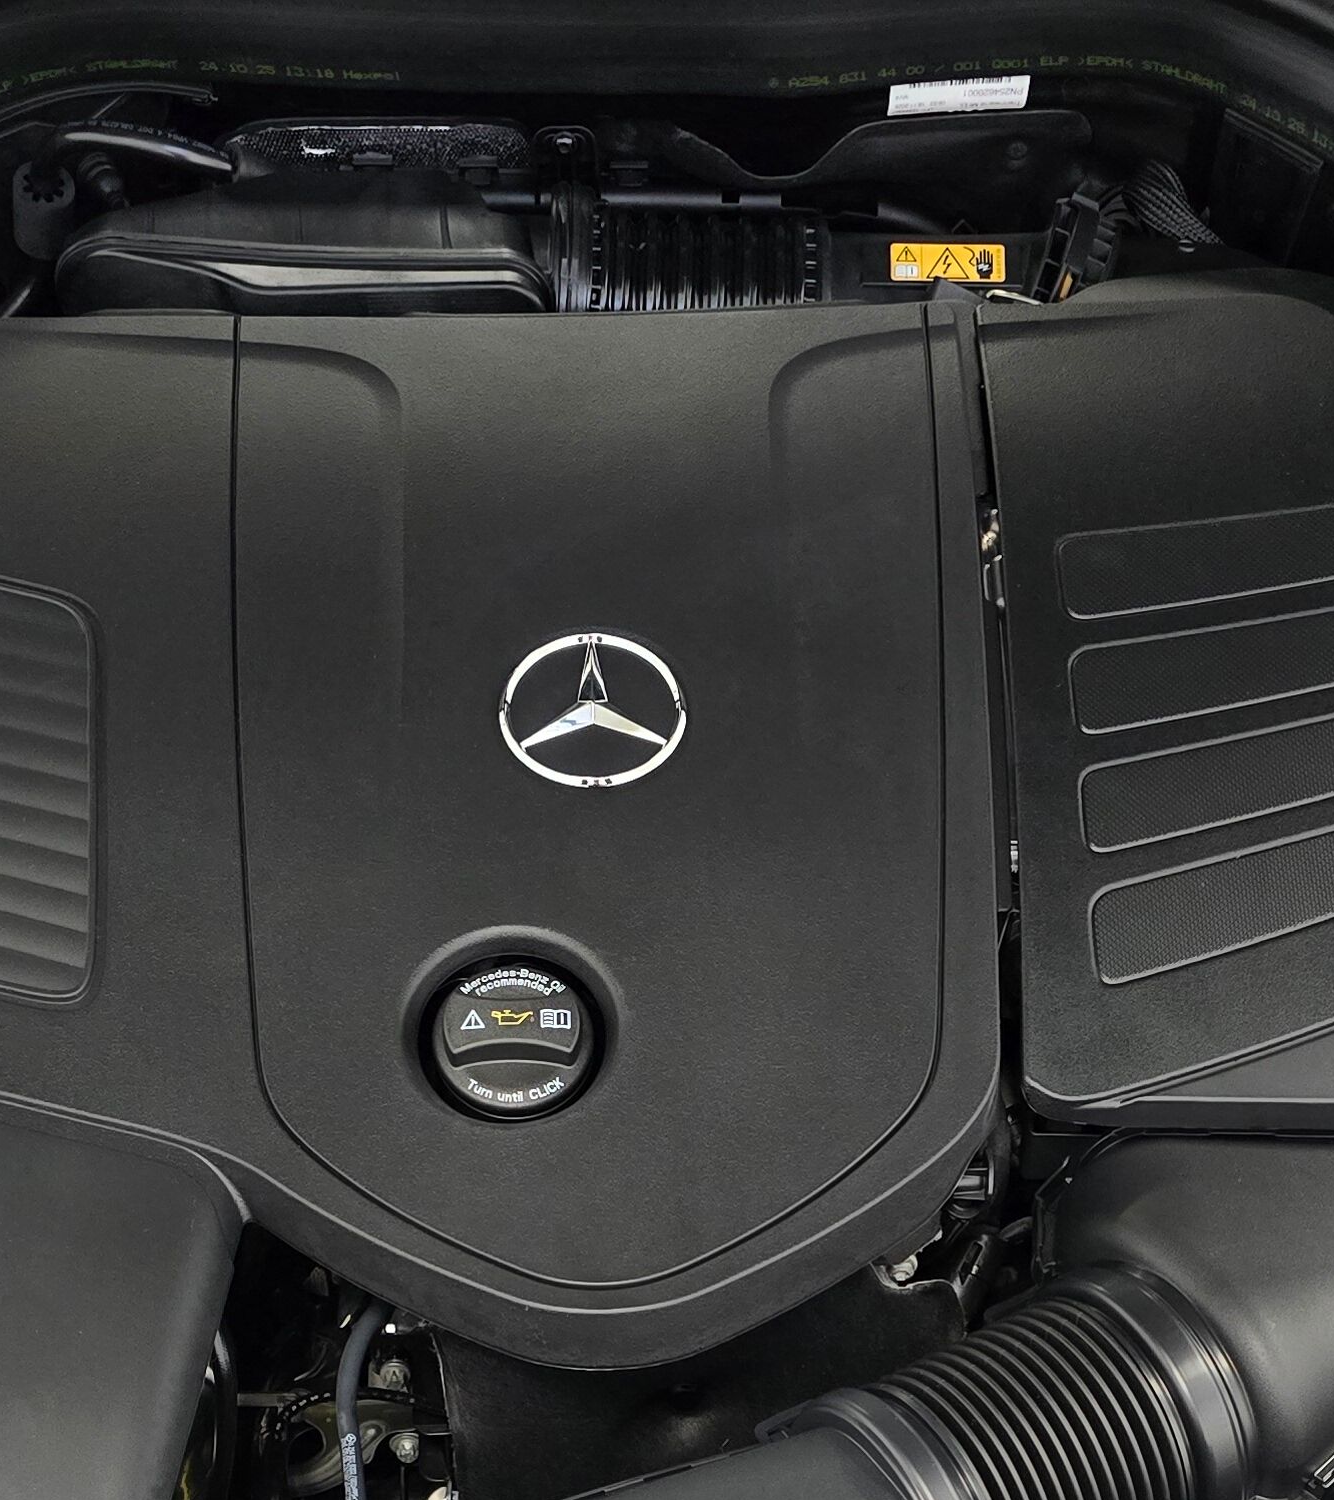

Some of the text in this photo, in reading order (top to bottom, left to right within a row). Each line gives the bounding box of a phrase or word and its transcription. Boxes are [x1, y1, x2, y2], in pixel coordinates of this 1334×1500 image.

[788, 76, 829, 89] A254
[878, 67, 898, 78] 44
[906, 65, 925, 75] 00
[954, 60, 980, 71] 001
[460, 968, 567, 996] Mercedes-Benz Oil
[475, 978, 554, 997] recommended
[466, 1077, 565, 1103] Turn until CLICK
